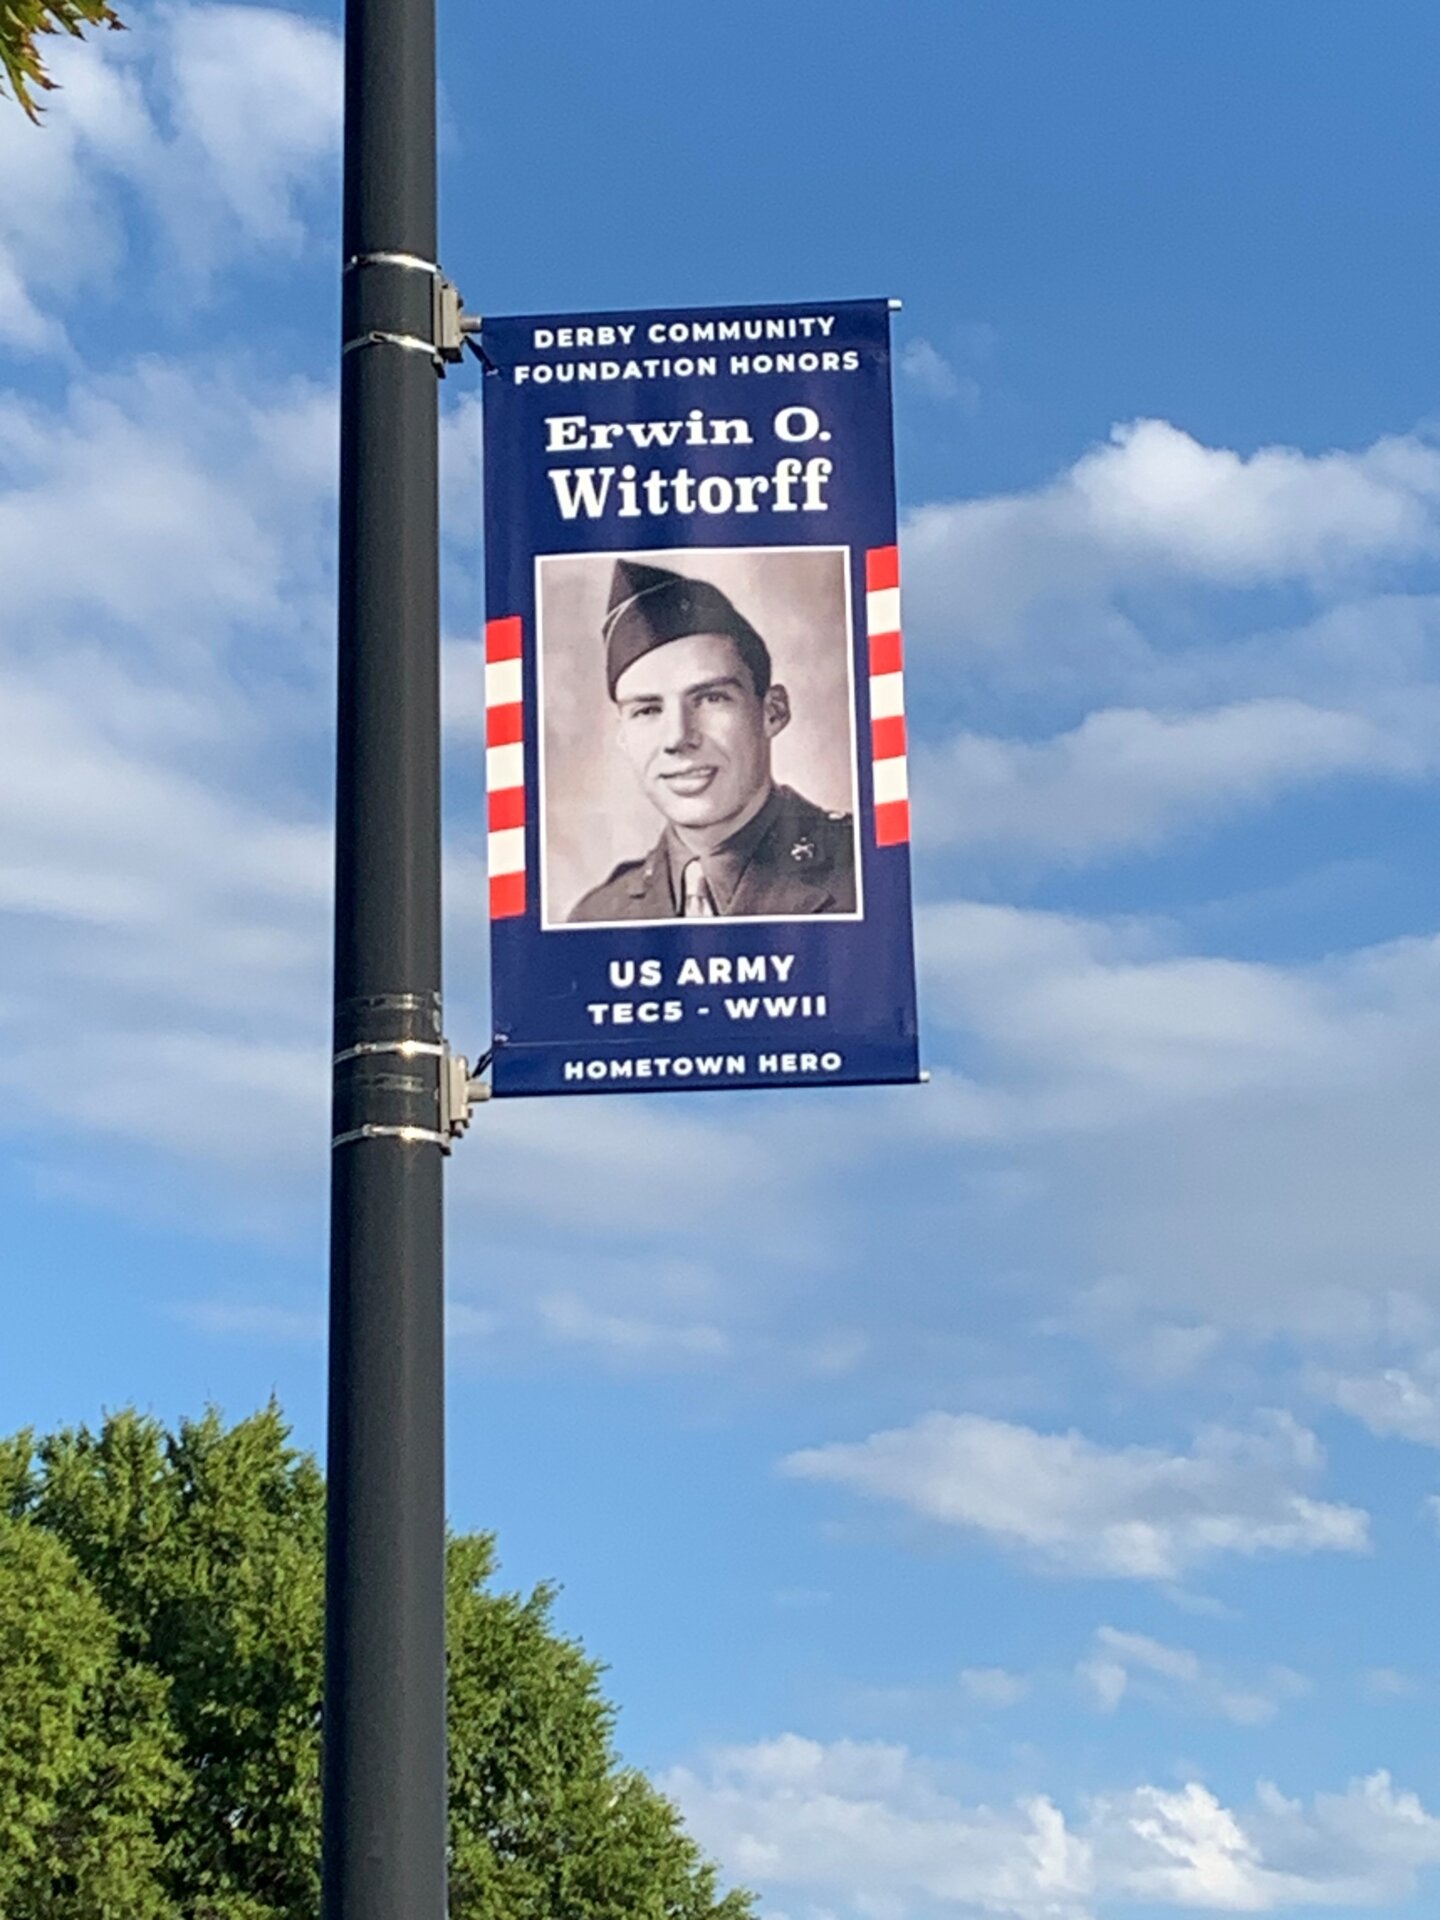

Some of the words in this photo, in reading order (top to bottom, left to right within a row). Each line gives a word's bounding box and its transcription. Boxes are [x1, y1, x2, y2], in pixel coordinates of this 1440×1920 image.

[534, 325, 636, 349] DERBY
[648, 316, 835, 344] COMMUNITY
[514, 356, 717, 385] FOUNDATION
[730, 350, 859, 375] HONORS
[544, 409, 754, 452] Erwin
[774, 406, 832, 443] O.
[547, 457, 833, 520] Wittorff
[609, 959, 662, 989] US
[676, 954, 795, 986] ARMY
[587, 1000, 683, 1025] TEC5
[697, 1007, 710, 1015] -
[724, 995, 827, 1020] WWII
[564, 1055, 746, 1080] HOMETOWN
[758, 1052, 842, 1073] HERO
